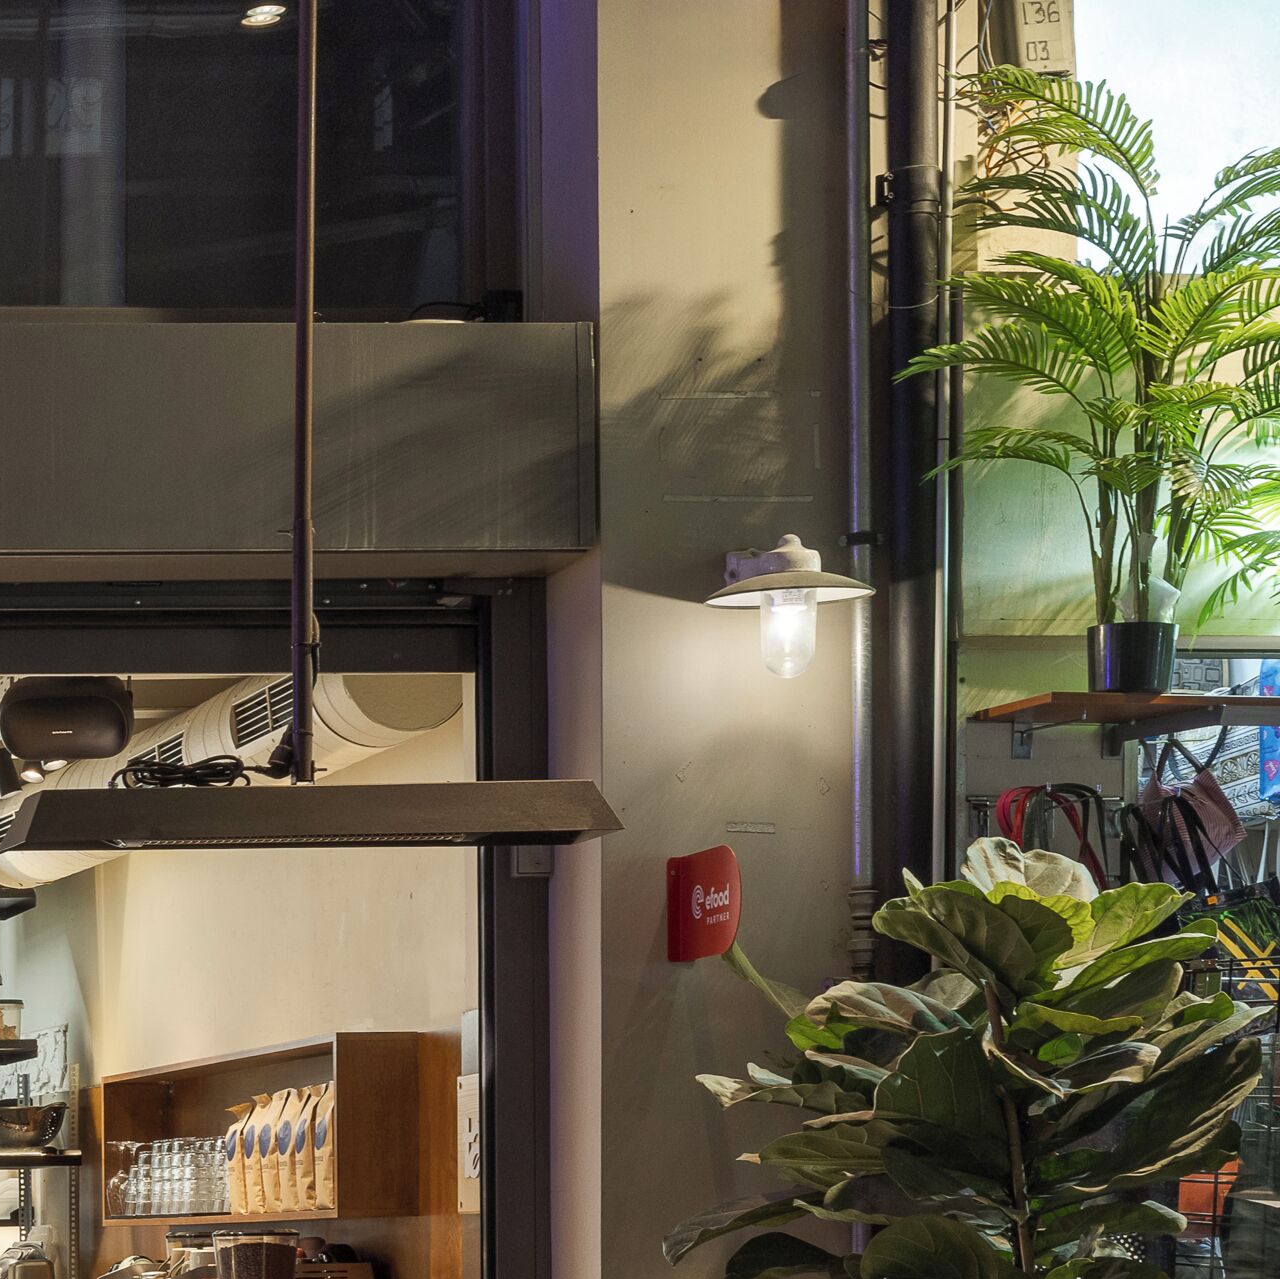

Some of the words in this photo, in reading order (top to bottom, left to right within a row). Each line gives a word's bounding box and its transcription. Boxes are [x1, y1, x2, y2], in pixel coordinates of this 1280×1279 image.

[1023, 1, 1060, 25] 136
[705, 883, 730, 910] efood
[706, 911, 730, 926] PARTNER
